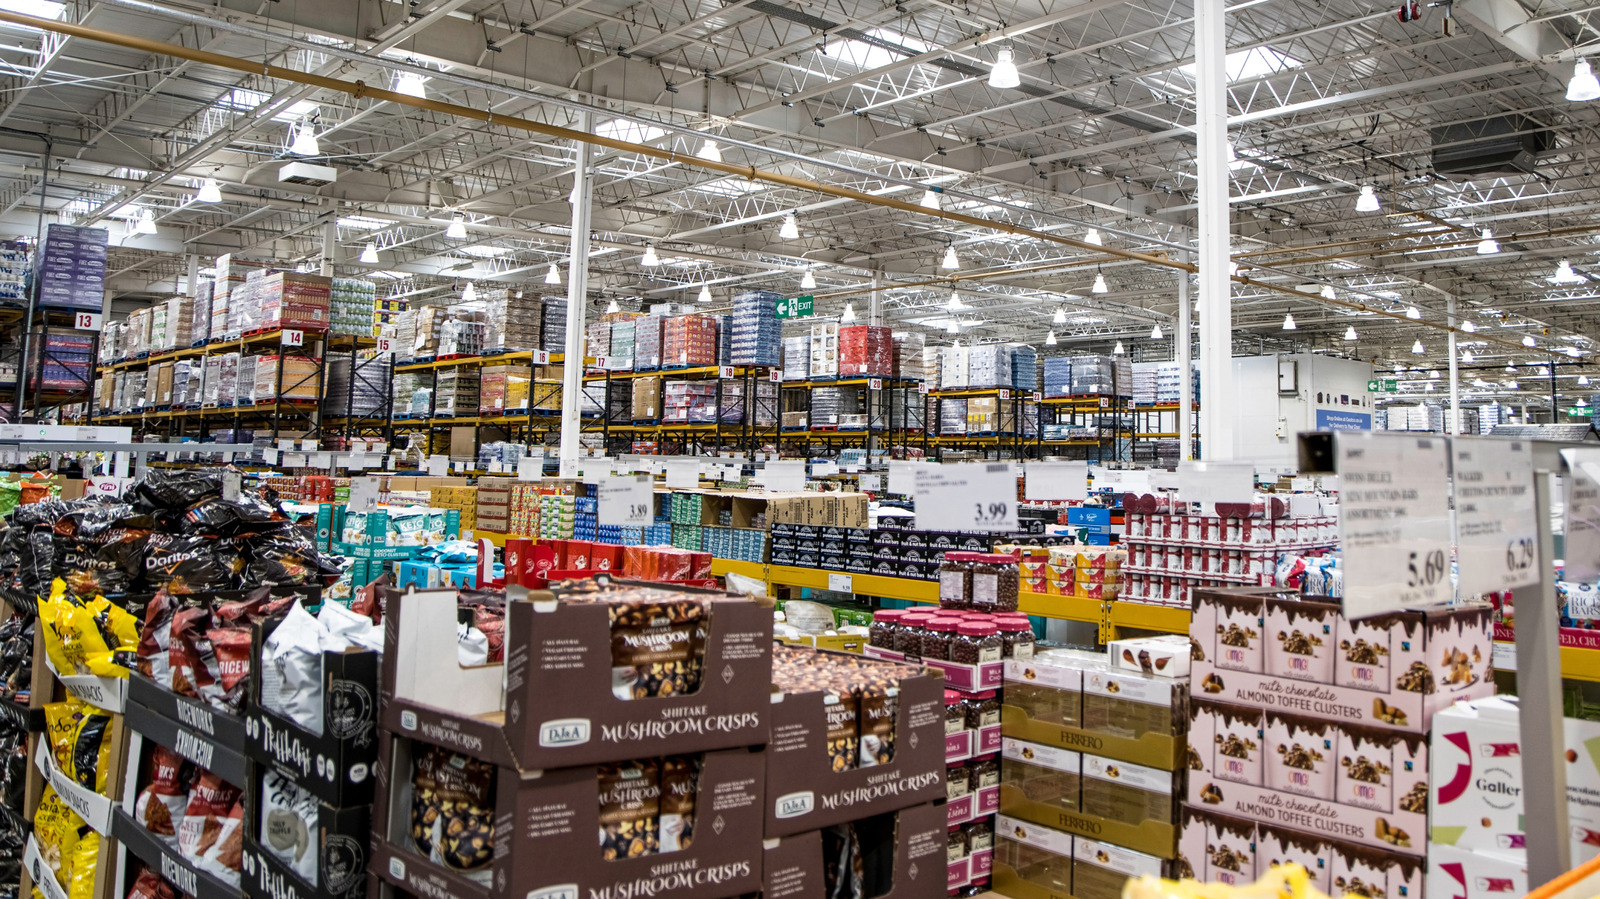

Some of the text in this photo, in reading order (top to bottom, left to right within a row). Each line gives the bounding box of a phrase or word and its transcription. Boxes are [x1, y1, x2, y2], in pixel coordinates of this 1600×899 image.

[798, 301, 812, 311] EXIT
[79, 315, 92, 327] 13
[291, 332, 300, 343] 14
[380, 340, 389, 350] 15
[539, 352, 546, 362] 16
[598, 358, 605, 367] 17
[726, 368, 733, 377] 18
[771, 372, 778, 380] 19
[873, 380, 881, 389] 20
[630, 504, 647, 518] 3.89
[975, 502, 1007, 521] 3.99
[400, 518, 424, 531] KETO
[65, 553, 117, 570] Doritos
[146, 549, 198, 570] Doritos
[1507, 538, 1534, 571] 6.29
[1408, 549, 1444, 588] 5.69
[624, 631, 690, 647] MUSHROOM
[1258, 680, 1284, 694] milk
[1283, 682, 1338, 702] chocolate
[662, 705, 708, 719] SHIITAKE
[1236, 688, 1363, 720] ALMOND TOFFEE CLUSTERS
[177, 698, 214, 736] RICEWORKS
[421, 722, 482, 751] MUSHROOM CRISPS
[601, 712, 759, 742] MUSHROOM CRISPS
[175, 729, 214, 770] RICEWORKS
[1060, 730, 1103, 751] FERRERO
[614, 779, 649, 790] SHIITAKE
[867, 770, 901, 785] SHIITAKE
[1476, 778, 1521, 796] Galler
[822, 770, 940, 810] MUSHROOM CRISPS
[71, 792, 90, 818] SNACKS
[1258, 793, 1284, 808] milk
[1285, 800, 1340, 819] chocolate
[1058, 813, 1102, 835] FERRERO
[1236, 802, 1364, 838] ALMOND TOFFEE CLUSTERS
[161, 851, 198, 899] RICEWORKS
[650, 858, 699, 877] SHIITAKE
[588, 870, 696, 899] MUSHROOM
[694, 860, 750, 884] CRISPS
